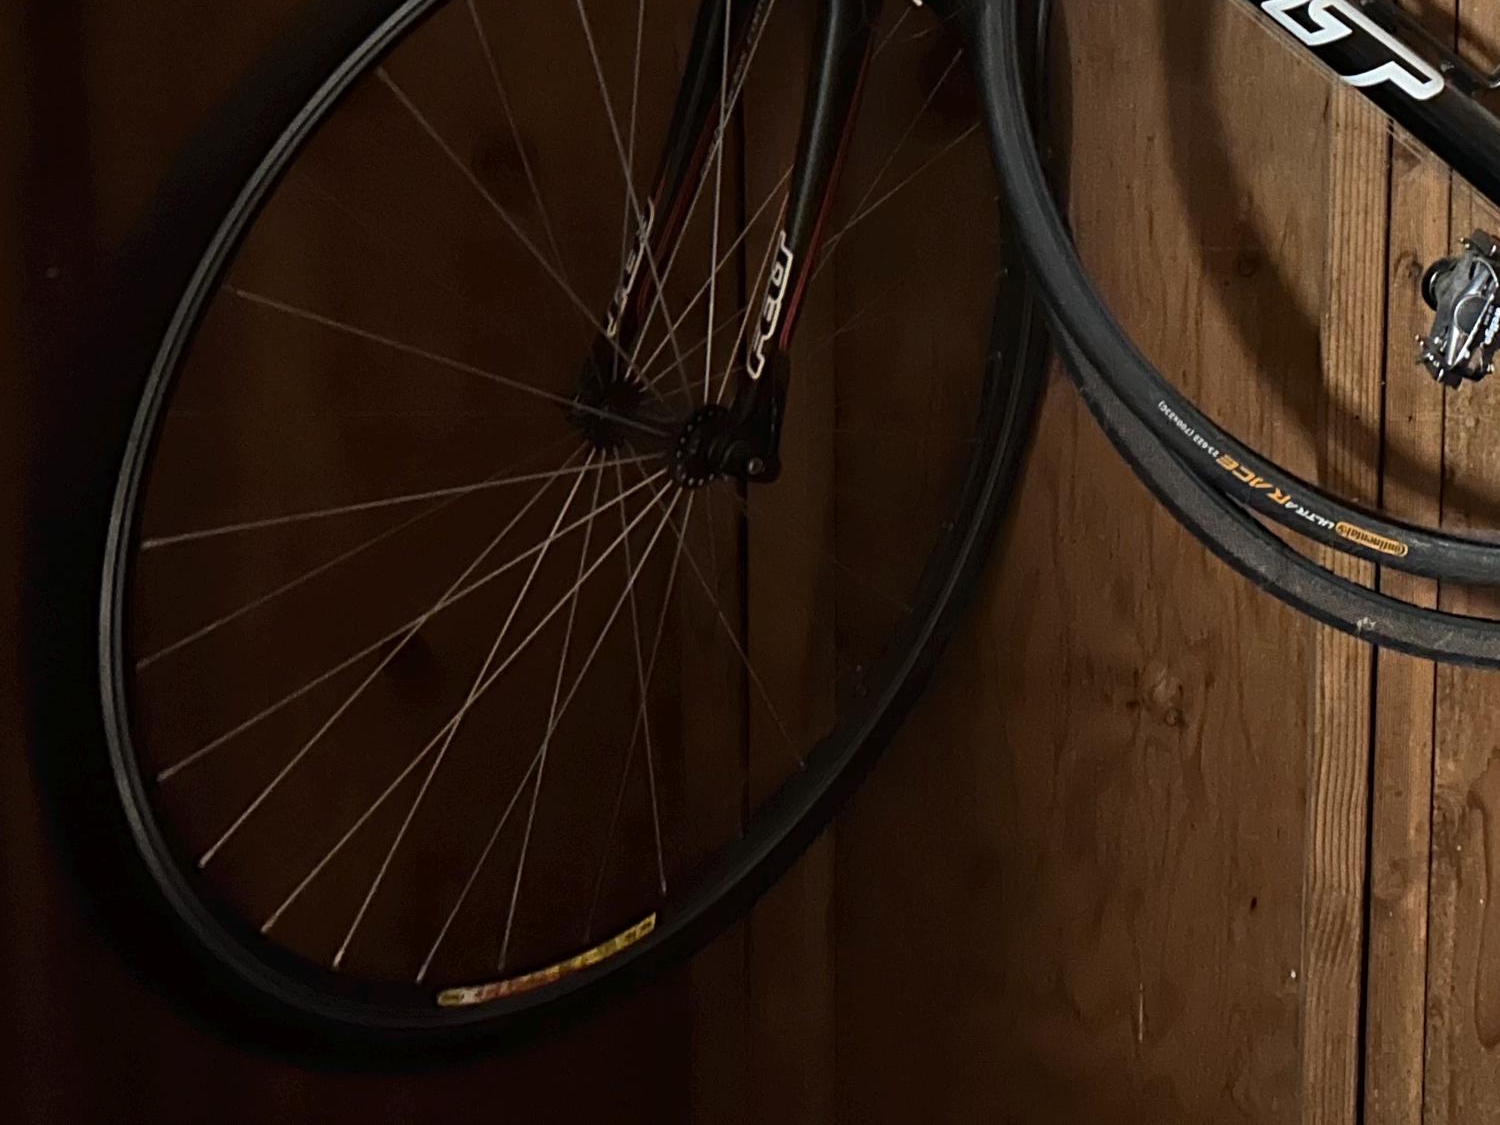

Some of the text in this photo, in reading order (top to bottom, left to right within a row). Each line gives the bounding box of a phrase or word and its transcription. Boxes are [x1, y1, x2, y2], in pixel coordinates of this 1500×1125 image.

[747, 230, 793, 379] FELT
[1215, 453, 1293, 506] RACE
[1285, 500, 1335, 530] ULTRA
